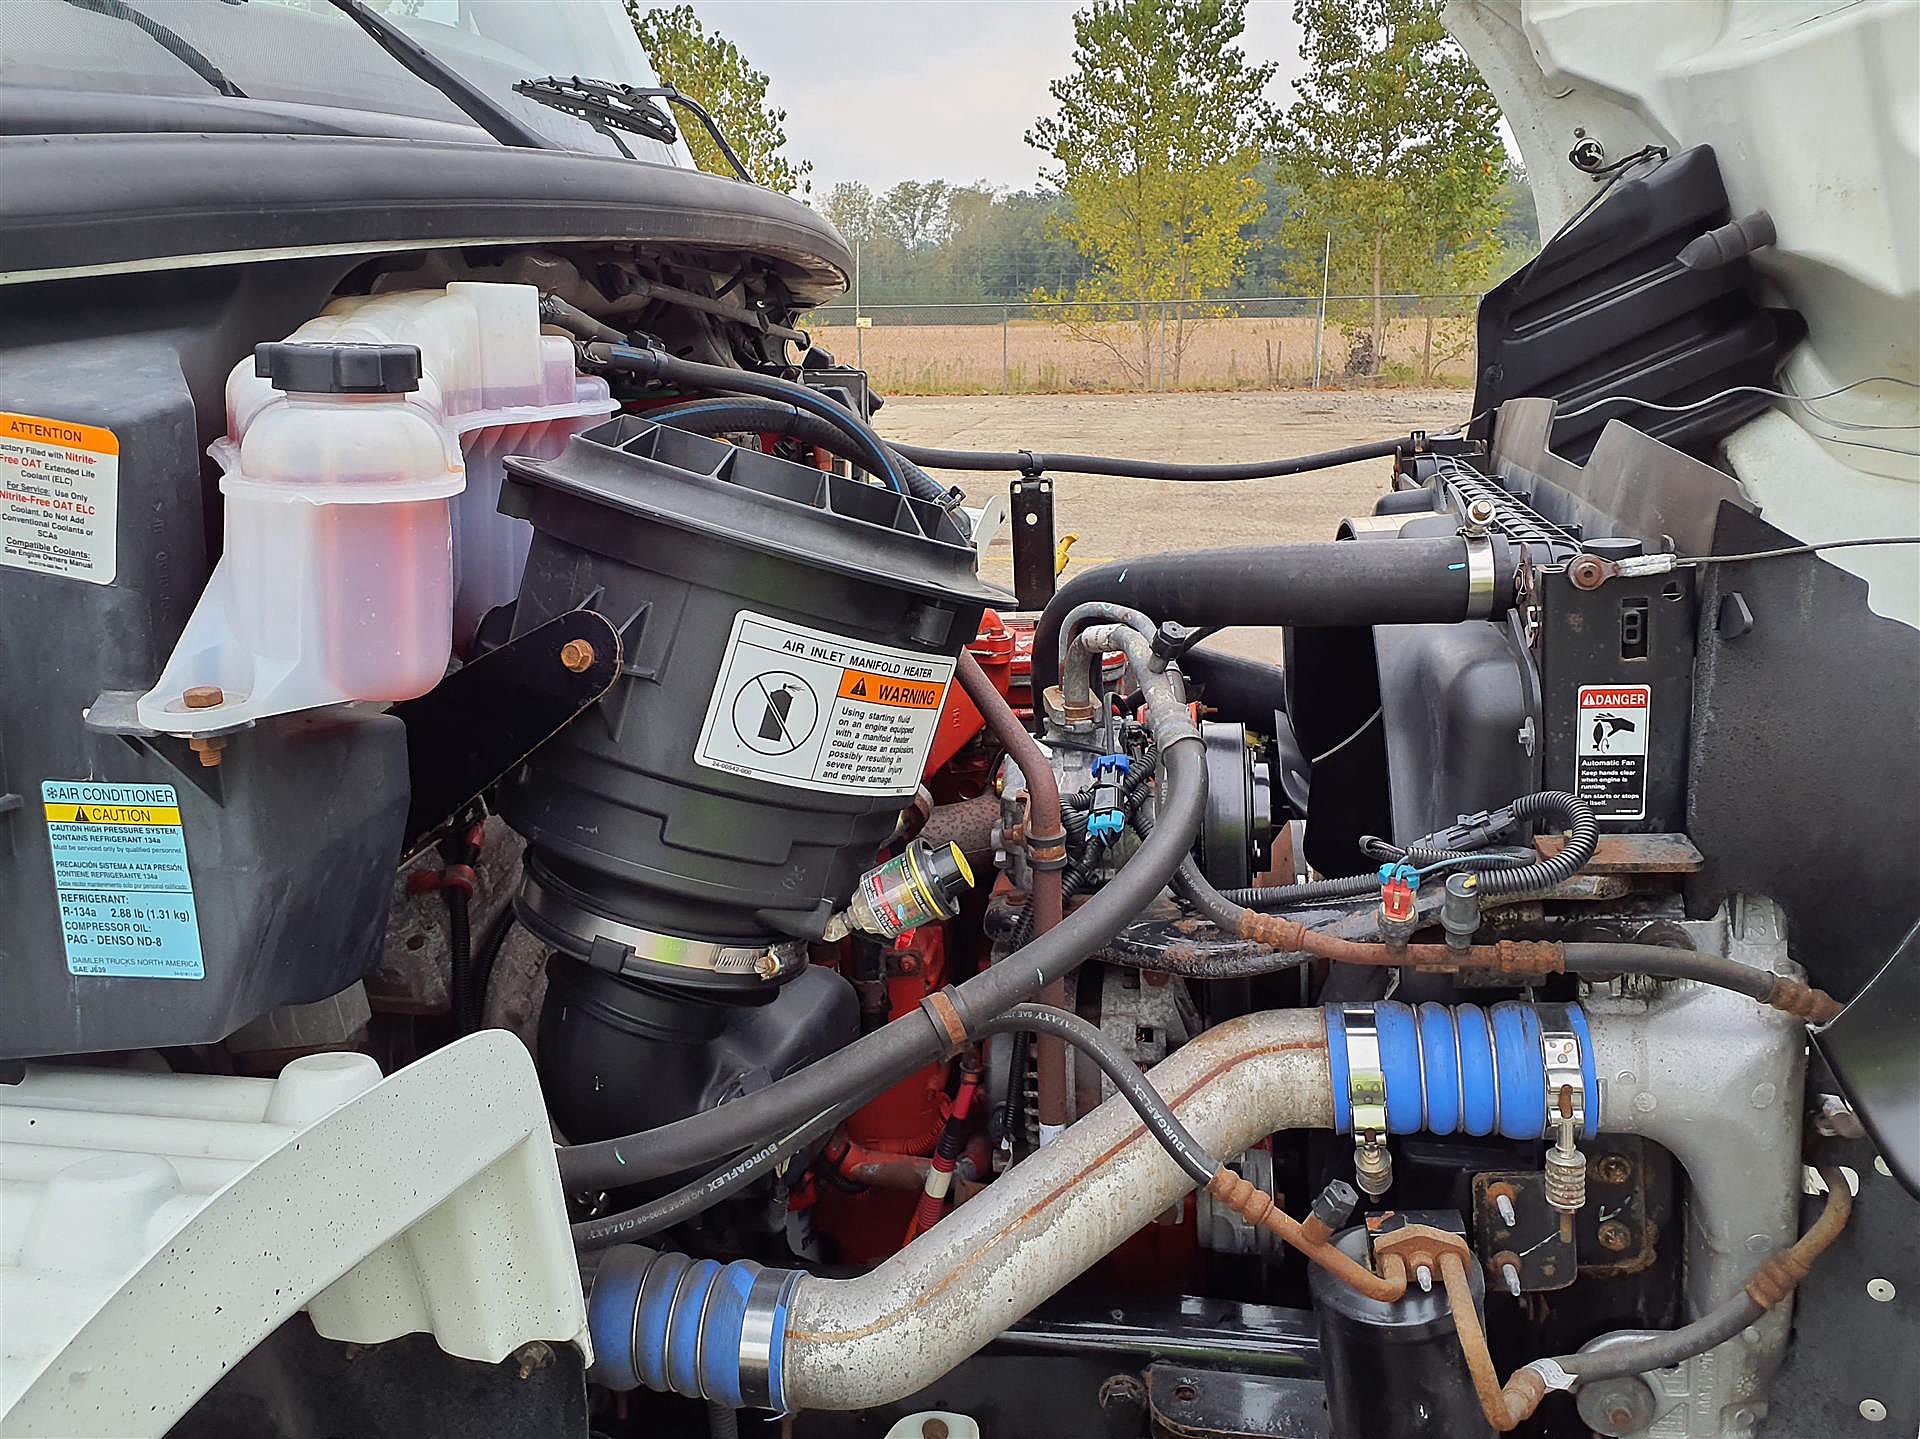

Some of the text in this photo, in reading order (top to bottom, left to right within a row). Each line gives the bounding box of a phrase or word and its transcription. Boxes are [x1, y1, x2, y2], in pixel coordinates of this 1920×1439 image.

[11, 421, 82, 442] ATTENTION
[0, 444, 97, 465] actory Filled with Nitrite-
[21, 457, 42, 468] OAT
[45, 463, 80, 476] Extended
[81, 469, 96, 479] Life
[21, 470, 73, 487] Coolant (ELC)
[7, 480, 89, 503] For Service: Use Only
[0, 491, 96, 515] Nitrite-Free OAT ELC
[11, 505, 85, 525] Coolant. Do Not Add
[2, 513, 50, 528] Conventional
[52, 522, 84, 535] Coolants
[37, 529, 58, 540] SCAs
[6, 536, 92, 560] Compatible Coolants:
[18, 549, 41, 559] Engine
[43, 553, 68, 564] Owners
[69, 558, 94, 569] Manual
[783, 640, 932, 678] AIR INLET MANIFOLD HEATER
[878, 684, 936, 705] WARNING
[1595, 694, 1645, 705] DANGER
[842, 706, 911, 724] Using starting fluid
[835, 729, 852, 738] with
[862, 733, 892, 743] manifold
[893, 736, 910, 744] heater
[865, 723, 888, 733] engine
[889, 726, 915, 735] equipped
[832, 740, 855, 749] could
[857, 744, 877, 752] cause
[828, 750, 863, 763] possibly
[866, 755, 894, 765] resulting
[825, 761, 903, 775] severe personal injury
[822, 771, 839, 779] and
[841, 773, 866, 783] engine
[59, 788, 174, 802] AIR CONDITIONER
[92, 808, 150, 822] CAUTION
[50, 824, 81, 832] CAUTION
[90, 835, 142, 843] REFRIGERANT
[56, 861, 97, 869] PRECAUCIÓN
[99, 862, 128, 870] SISTEMA
[57, 870, 90, 878] CONTIENE
[90, 871, 141, 879] REFRIGERANTE
[61, 894, 128, 904] REFRIGERANT:
[63, 907, 189, 922] R-134a 2.88 lb (1.31 kg)
[65, 921, 152, 932] COMPRESSOR OIL:
[67, 934, 88, 944] PAG
[97, 935, 134, 945] DENSO
[137, 937, 162, 946] ND-8
[106, 958, 136, 966] TRUCKS
[165, 960, 199, 968] AMERICA
[708, 1143, 778, 1193] BURGAFLEX
